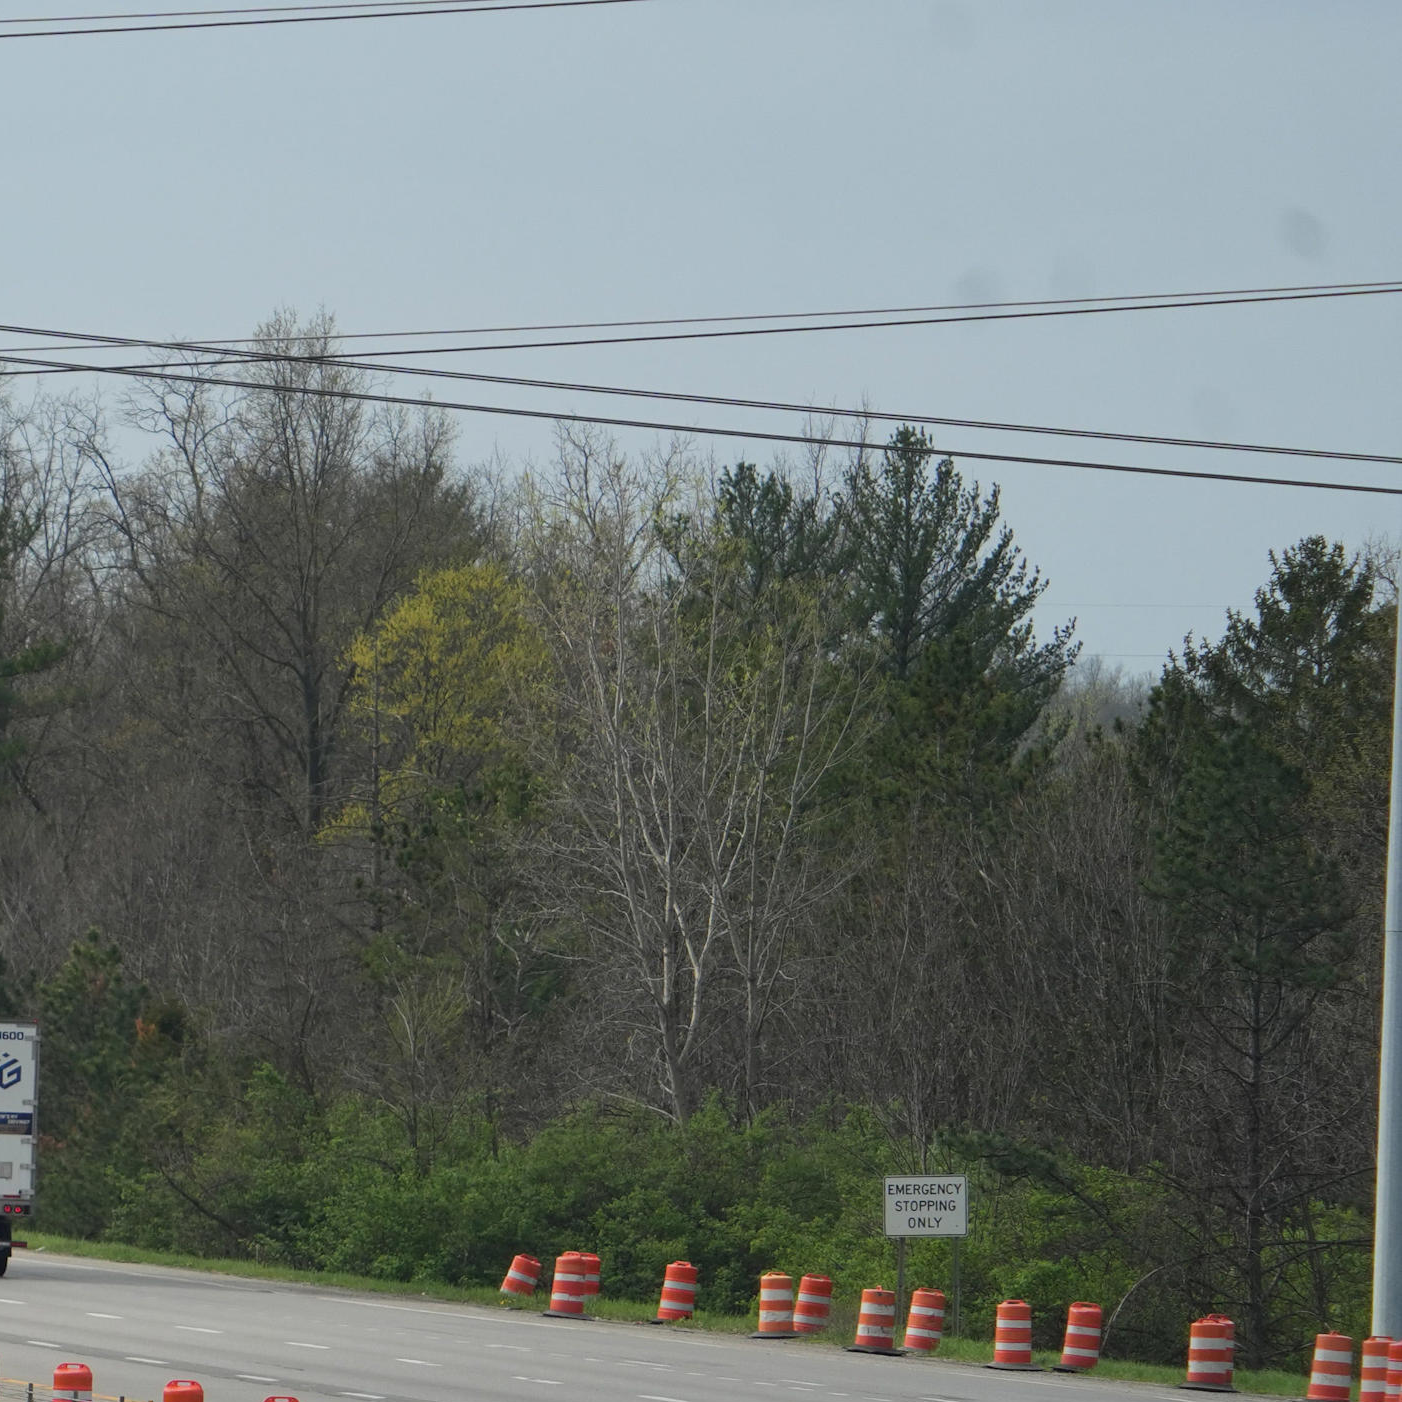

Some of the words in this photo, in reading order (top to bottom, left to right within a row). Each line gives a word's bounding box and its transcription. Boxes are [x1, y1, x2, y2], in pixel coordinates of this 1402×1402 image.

[888, 1183, 962, 1196] EMERGENCY
[895, 1200, 957, 1212] STOPPING
[908, 1217, 943, 1229] ONLY
